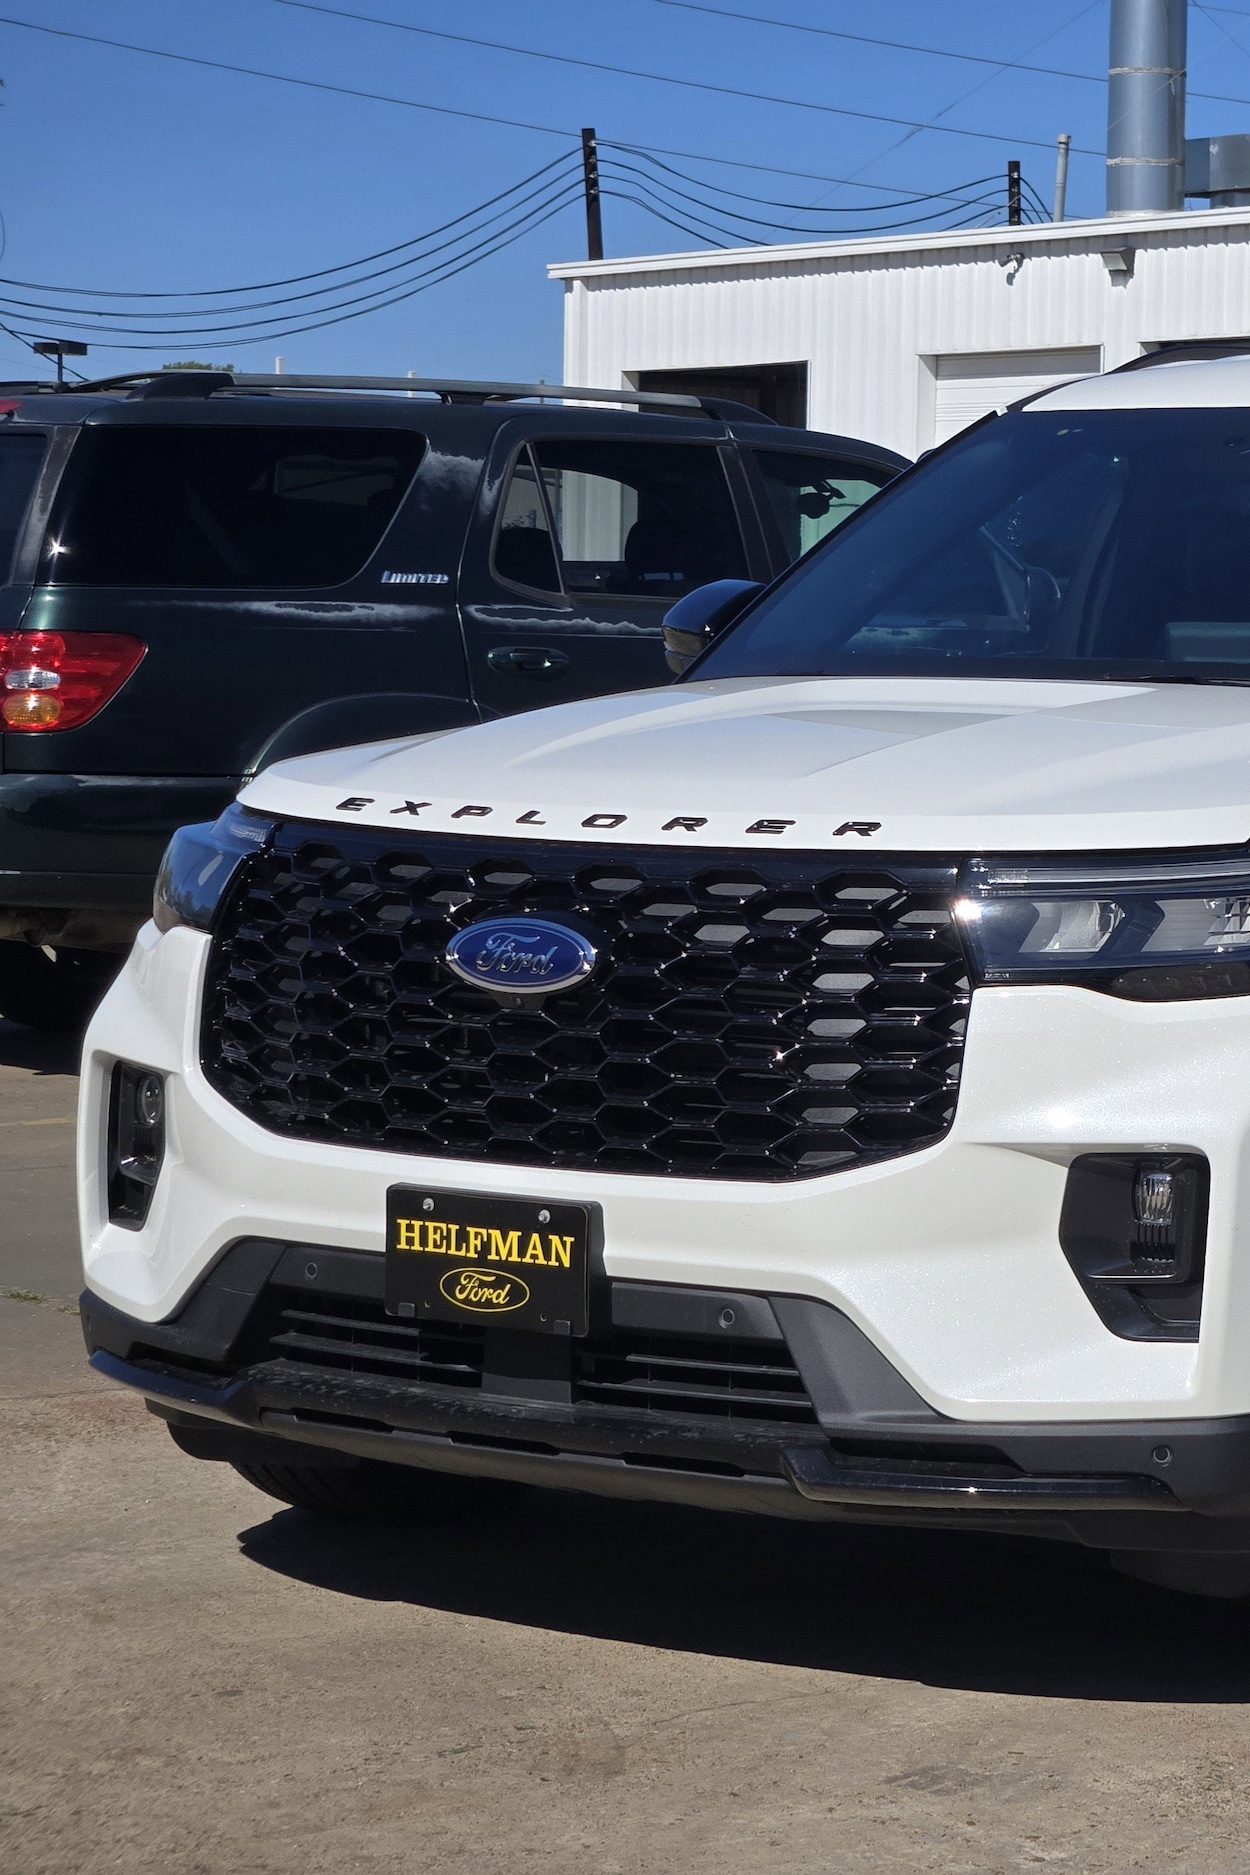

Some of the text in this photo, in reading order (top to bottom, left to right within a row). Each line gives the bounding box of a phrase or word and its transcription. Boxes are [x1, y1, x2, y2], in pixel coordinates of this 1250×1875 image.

[336, 796, 883, 837] EXPLORER
[476, 932, 558, 975] Ford
[396, 1218, 575, 1268] HELFMAN
[455, 1272, 511, 1304] Ford
